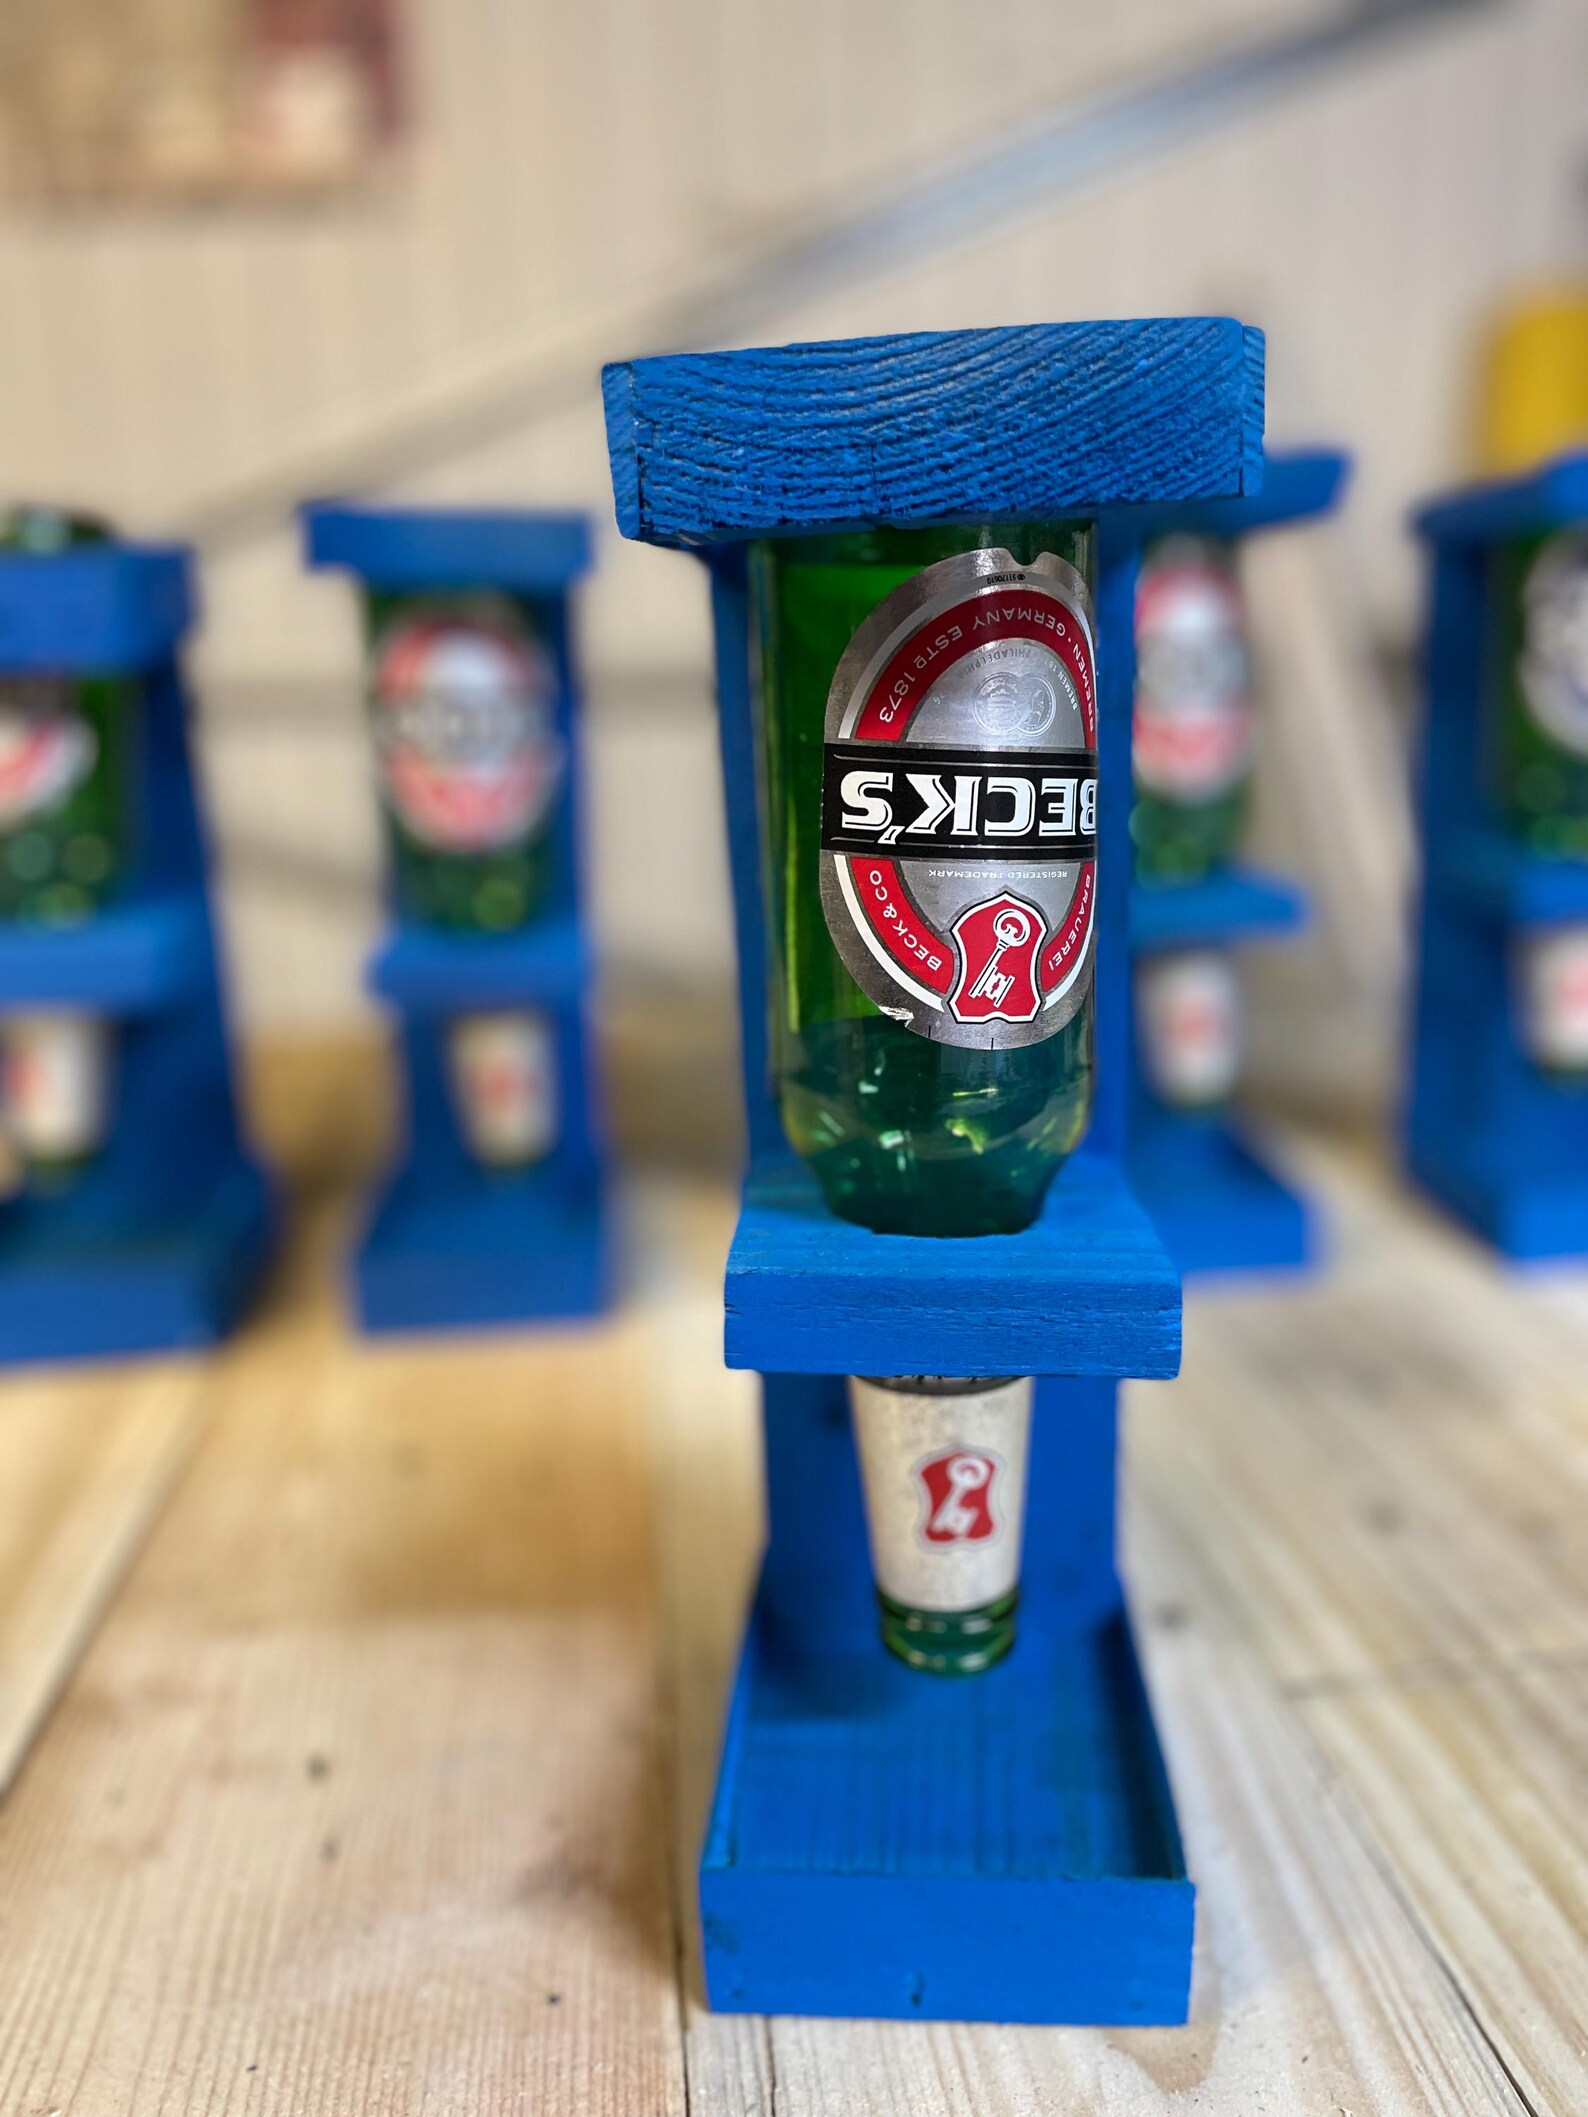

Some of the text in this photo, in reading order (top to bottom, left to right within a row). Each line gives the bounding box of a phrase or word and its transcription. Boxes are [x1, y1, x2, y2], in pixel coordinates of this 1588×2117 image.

[973, 607, 1066, 637] GERMANY
[879, 672, 916, 723] 1873
[1057, 670, 1078, 711] BREMEN
[1073, 643, 1095, 732] BREMEN
[840, 770, 1097, 845] BECK'S
[928, 868, 1068, 879] REGISTERED TRADEMARK
[1049, 873, 1091, 971] BRAUEREI
